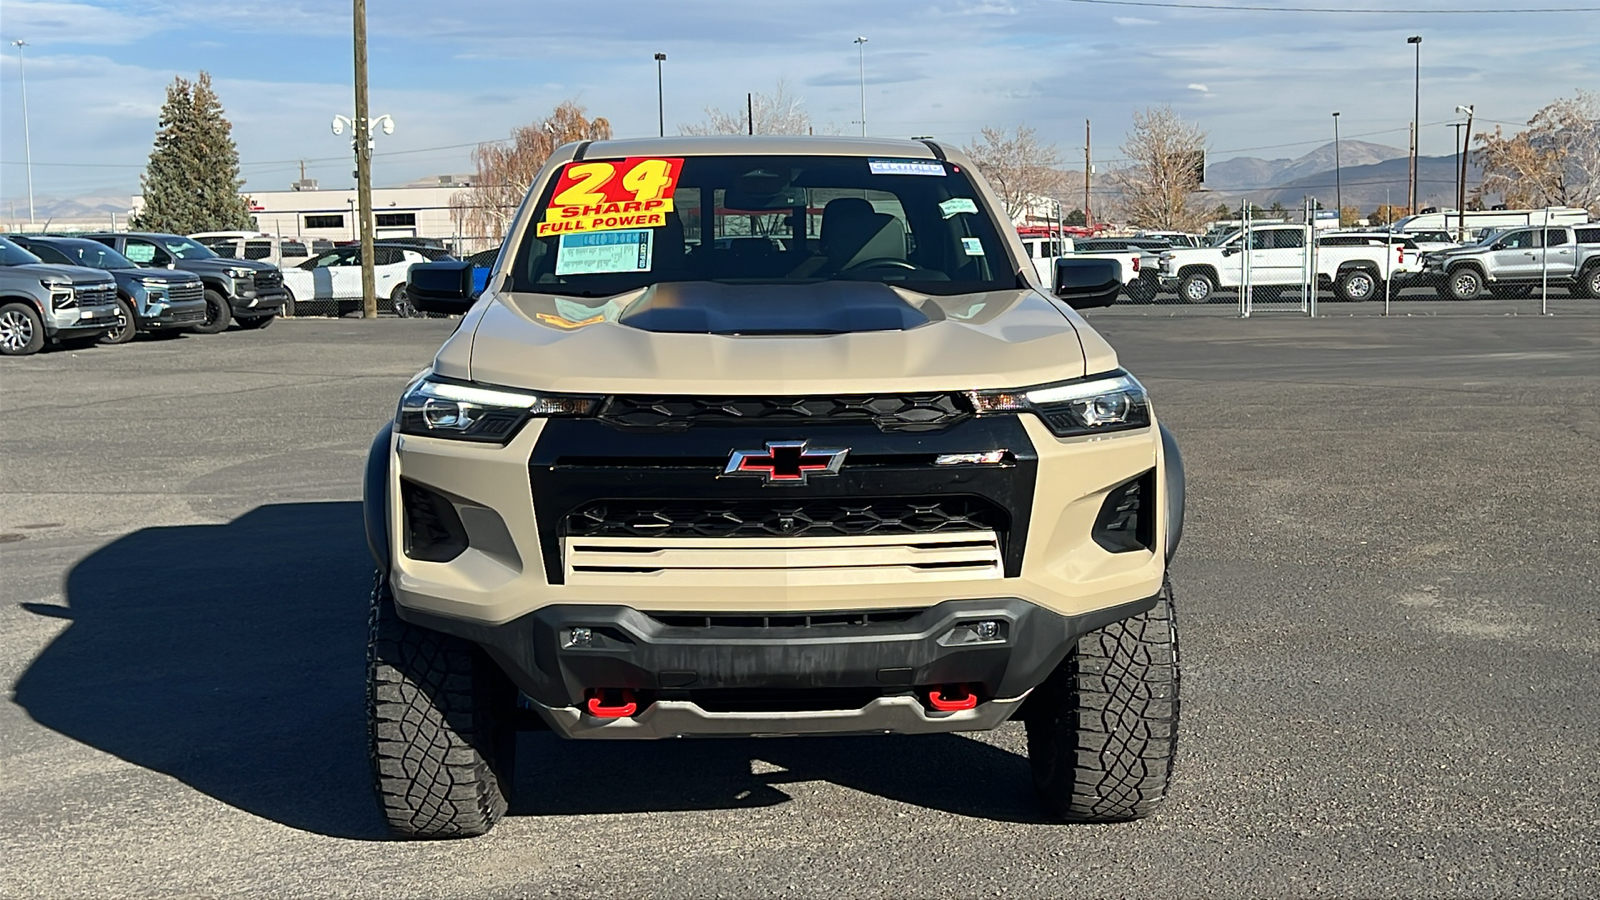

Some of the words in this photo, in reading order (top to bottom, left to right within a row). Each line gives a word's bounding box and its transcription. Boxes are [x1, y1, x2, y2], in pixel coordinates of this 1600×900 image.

[872, 163, 941, 172] CERTIFIED
[554, 159, 673, 205] 24
[561, 200, 664, 218] SHARP
[539, 220, 585, 234] FULL
[592, 214, 661, 228] POWER
